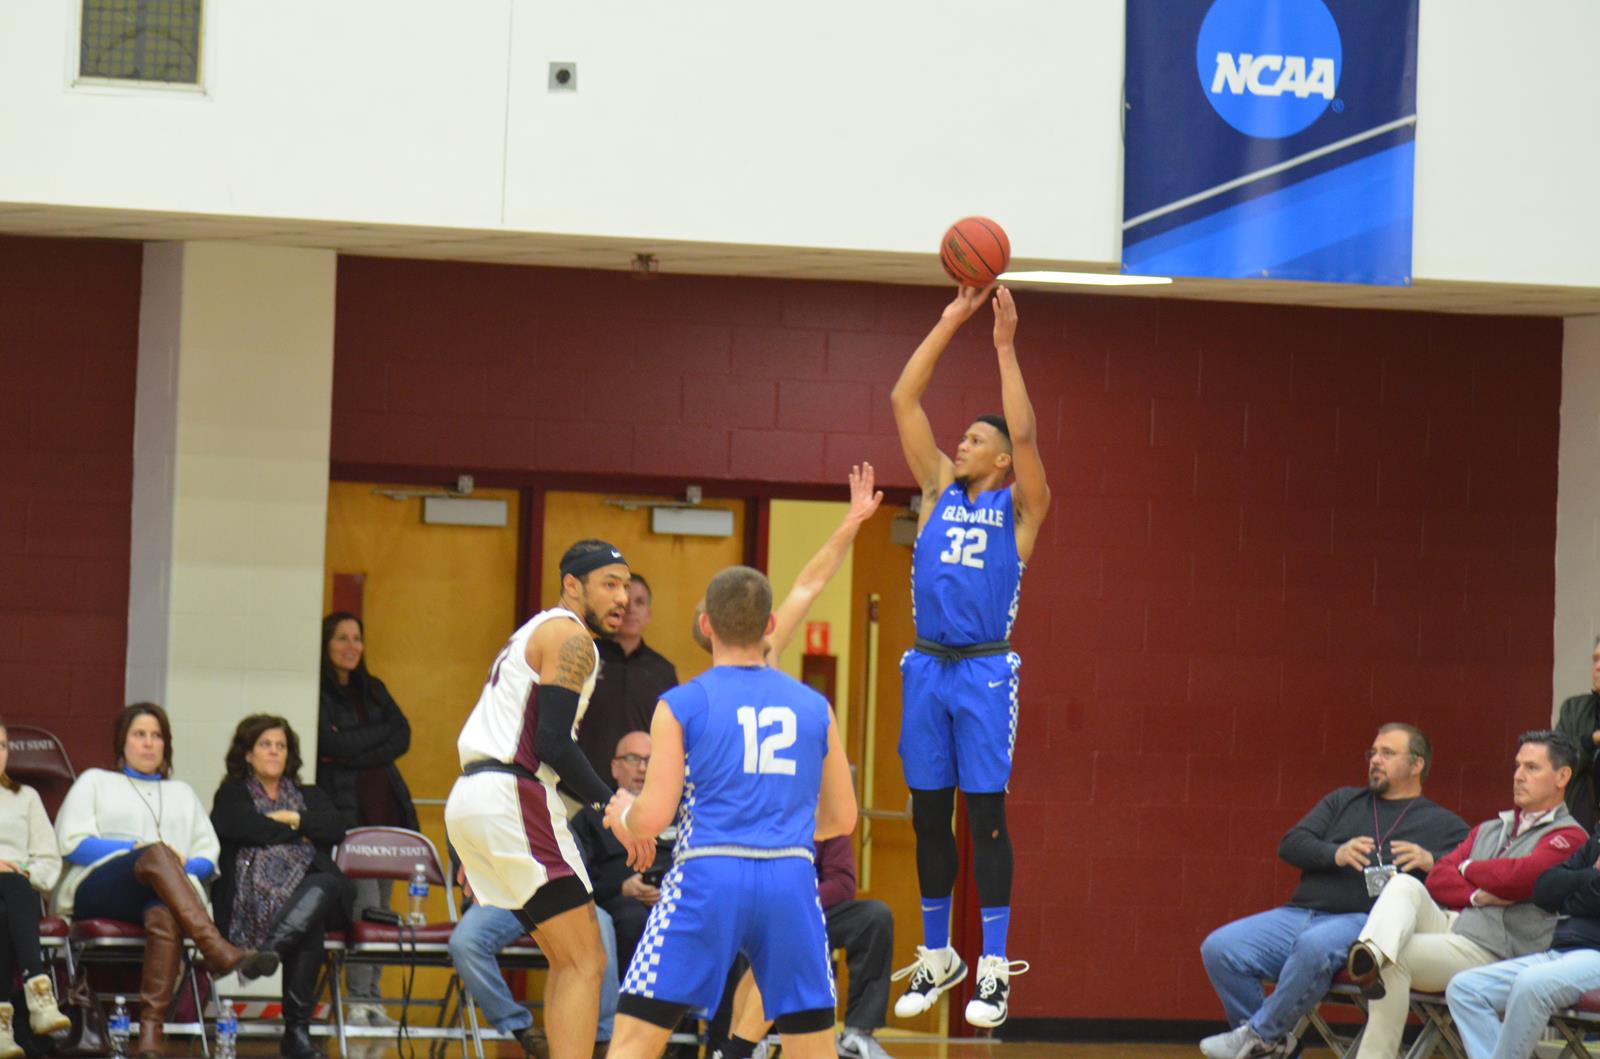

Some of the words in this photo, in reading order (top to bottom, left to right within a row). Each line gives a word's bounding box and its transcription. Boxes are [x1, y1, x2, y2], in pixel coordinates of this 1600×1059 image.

[1211, 52, 1336, 100] NCAA
[942, 505, 1004, 528] GLENVILLE
[940, 527, 988, 569] 32
[737, 705, 797, 776] 12
[345, 844, 398, 857] FAIRMONT
[399, 845, 429, 857] STATE
